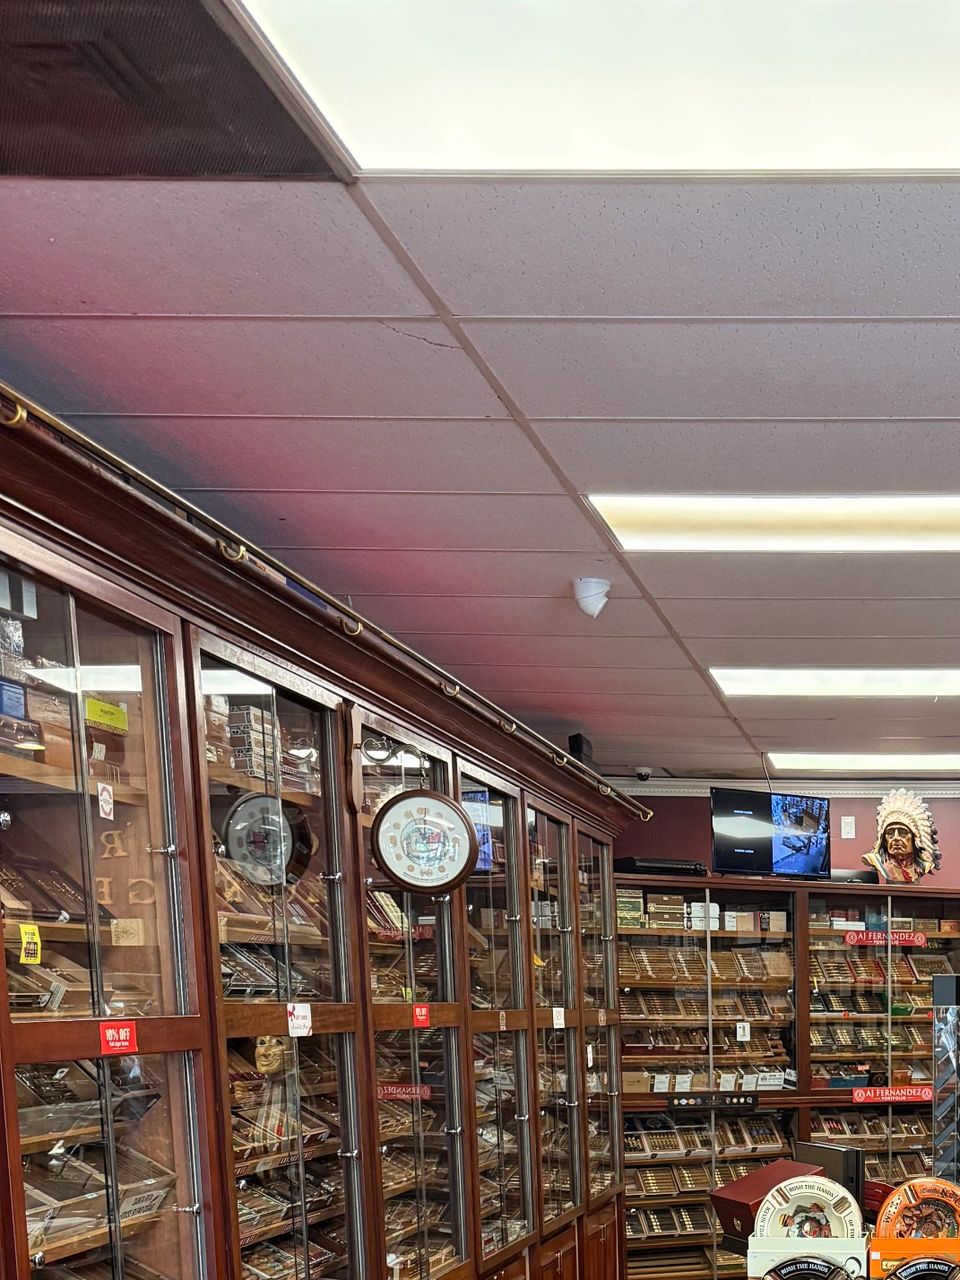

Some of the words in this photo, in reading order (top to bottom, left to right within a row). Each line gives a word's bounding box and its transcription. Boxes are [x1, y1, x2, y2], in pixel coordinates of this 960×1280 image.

[868, 932, 915, 941] FERNANDEZ
[105, 1028, 119, 1041] 10%
[119, 1028, 130, 1041] OFF
[866, 1088, 874, 1097] AJ
[876, 1088, 922, 1097] FERNANDEZ
[816, 1185, 835, 1199] HANDS
[780, 1263, 796, 1275] RUSH
[809, 1263, 829, 1274] HANDS
[900, 1265, 916, 1277] RUSH
[916, 1264, 929, 1272] THE
[929, 1264, 949, 1273] HANDS
